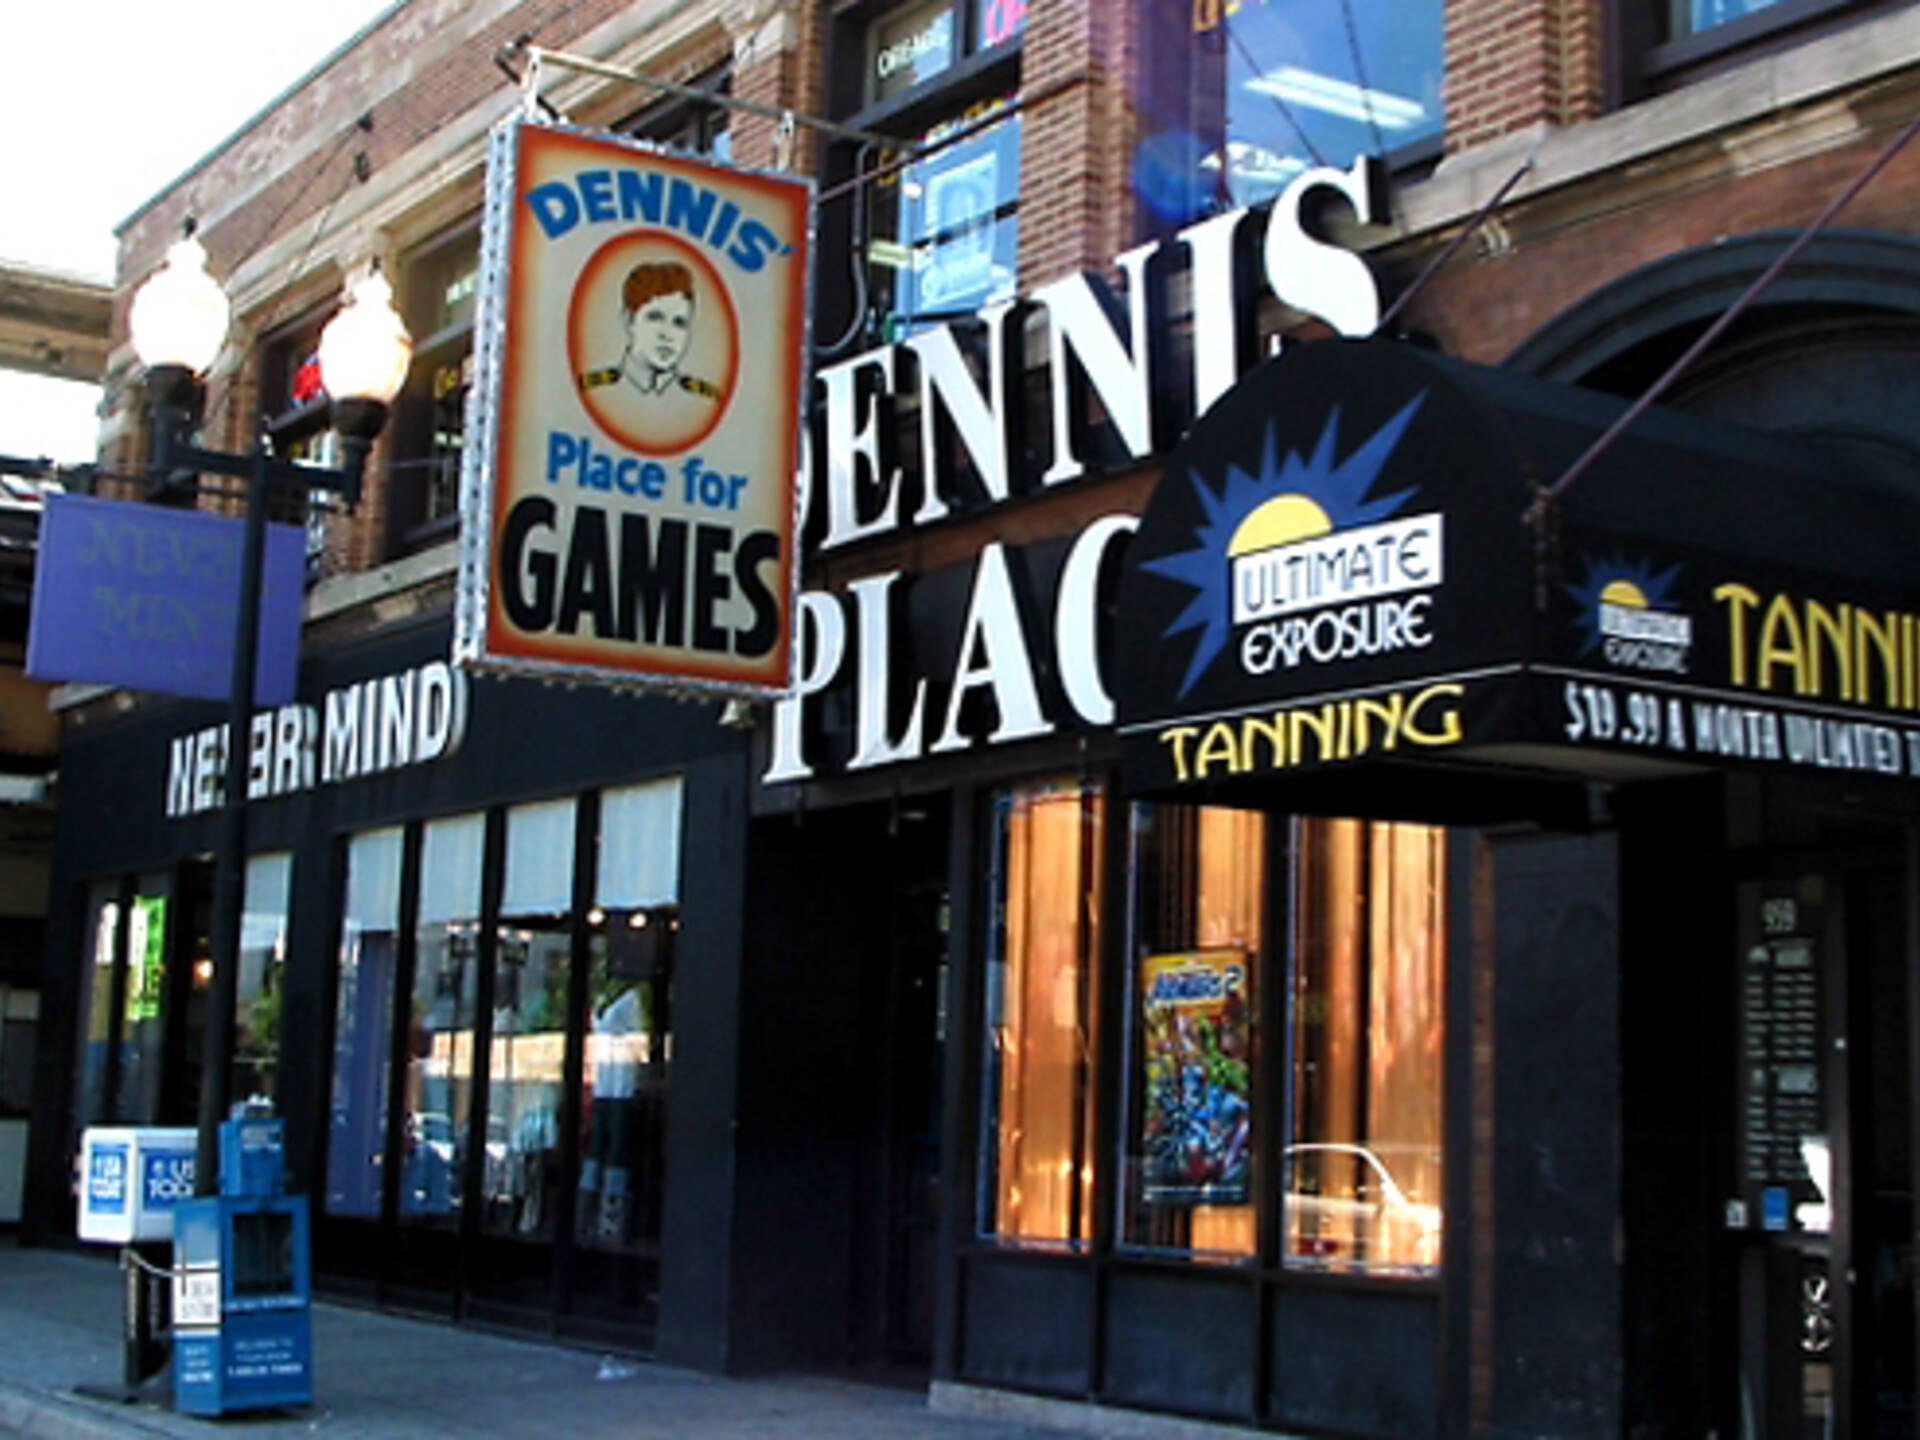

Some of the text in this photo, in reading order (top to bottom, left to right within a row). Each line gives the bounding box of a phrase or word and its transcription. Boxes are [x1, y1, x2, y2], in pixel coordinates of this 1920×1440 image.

[797, 154, 1379, 550] ENNIS
[546, 431, 748, 510] Place for
[500, 495, 781, 659] GAMES
[1243, 529, 1431, 613] ULTIMATE
[762, 514, 1141, 784] PLAC
[1241, 595, 1434, 675] EXPOSURE
[1711, 581, 1920, 710] TANNI
[320, 660, 467, 783] MIND
[1159, 683, 1465, 781] TANNING
